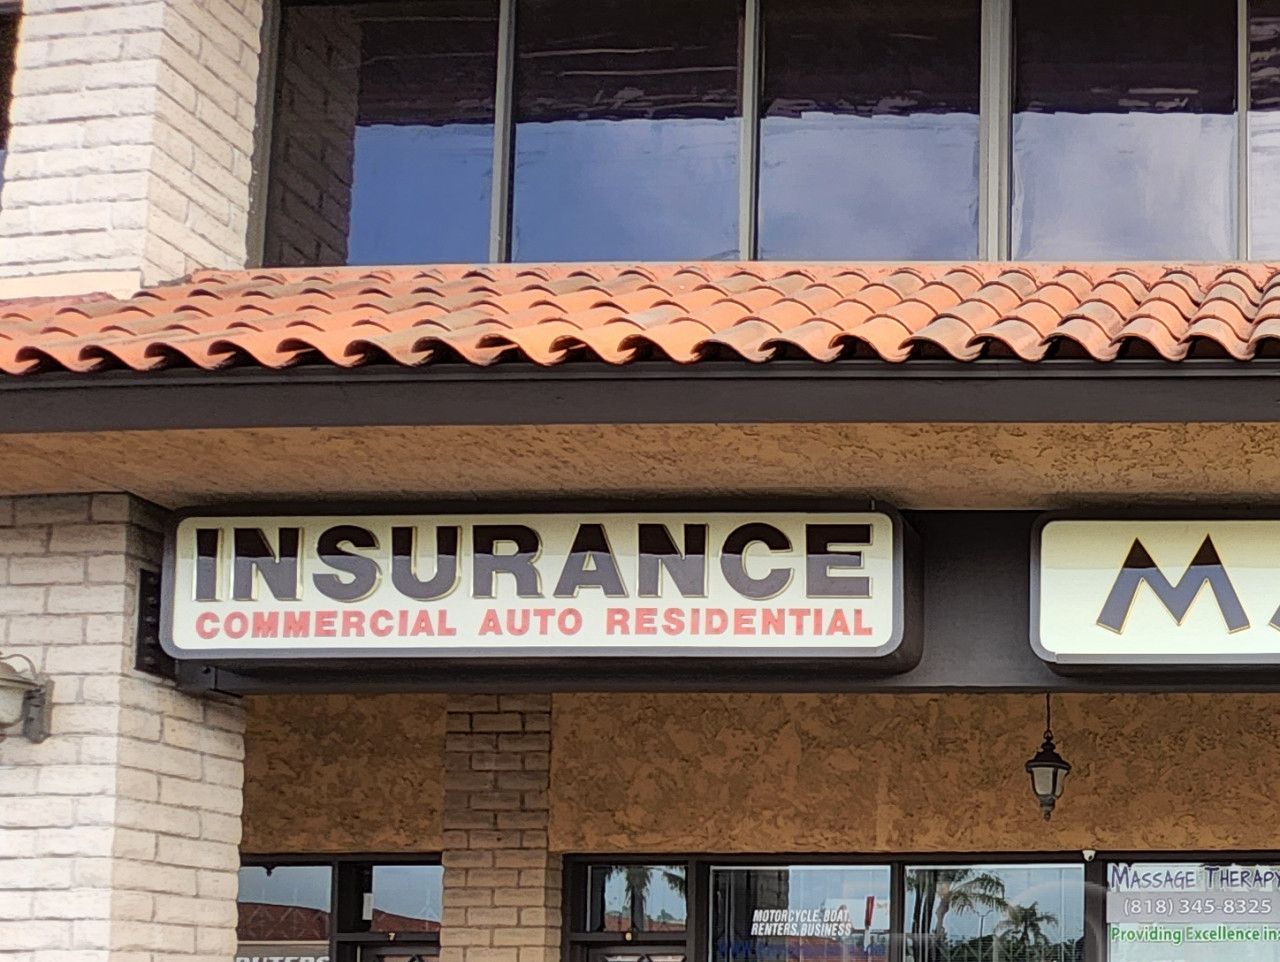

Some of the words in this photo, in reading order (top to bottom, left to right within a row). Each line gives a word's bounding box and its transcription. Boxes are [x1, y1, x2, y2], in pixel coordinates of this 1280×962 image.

[193, 521, 873, 603] INSURANCE
[195, 608, 457, 640] COMMERCIAL
[478, 607, 583, 638] AUTO
[605, 606, 873, 637] RESIDENTIAL
[1111, 866, 1196, 890] MASSAGE
[1124, 898, 1174, 916] (818)
[1179, 898, 1273, 915] 345-8325
[1111, 926, 1183, 945] Providing
[1186, 926, 1260, 942] Excellence
